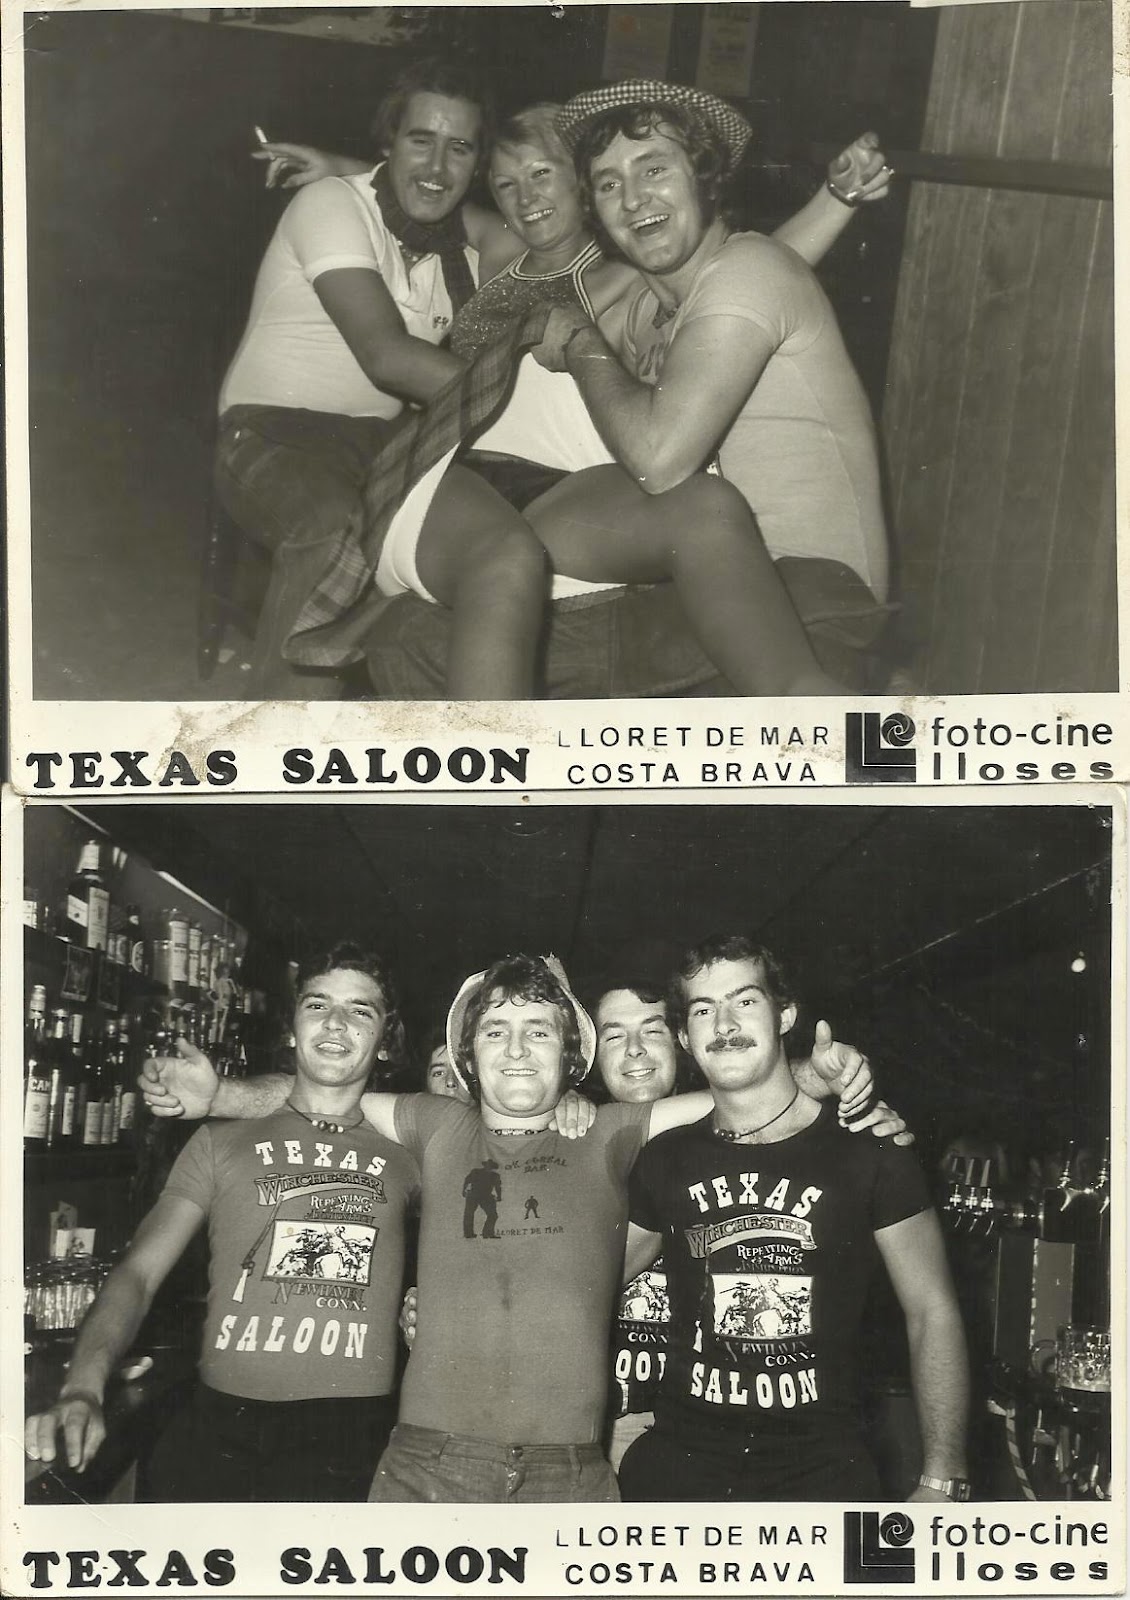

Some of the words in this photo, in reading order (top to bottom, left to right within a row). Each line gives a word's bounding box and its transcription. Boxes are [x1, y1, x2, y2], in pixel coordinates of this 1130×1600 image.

[557, 726, 692, 749] LLORET
[706, 726, 744, 748] DE
[760, 725, 829, 747] MAR
[931, 717, 1113, 748] foto-cine
[26, 749, 238, 788] TEXAS
[283, 746, 530, 784] SALOON
[567, 763, 680, 785] COSTA
[701, 761, 817, 783] BRAVA
[932, 751, 1115, 781] lloses
[255, 1140, 386, 1176] TEXAS
[256, 1173, 384, 1205] WINCHESTER
[688, 1173, 823, 1218] TEXAS
[335, 1202, 373, 1214] ARMS
[531, 1227, 541, 1235] DE
[685, 1216, 812, 1258] WINCHESTER
[762, 1253, 804, 1266] ARMS
[215, 1315, 368, 1359] SALOON
[690, 1362, 818, 1408] SALOON
[556, 1525, 690, 1548] LLORET
[704, 1526, 743, 1547] DE
[758, 1525, 828, 1546] MAR
[930, 1515, 1108, 1546] foto-cine
[23, 1549, 236, 1588] TEXAS
[280, 1546, 529, 1584] SALOON
[564, 1562, 679, 1585] COSTA
[699, 1561, 816, 1583] BRAVA
[931, 1551, 1108, 1581] lloses
